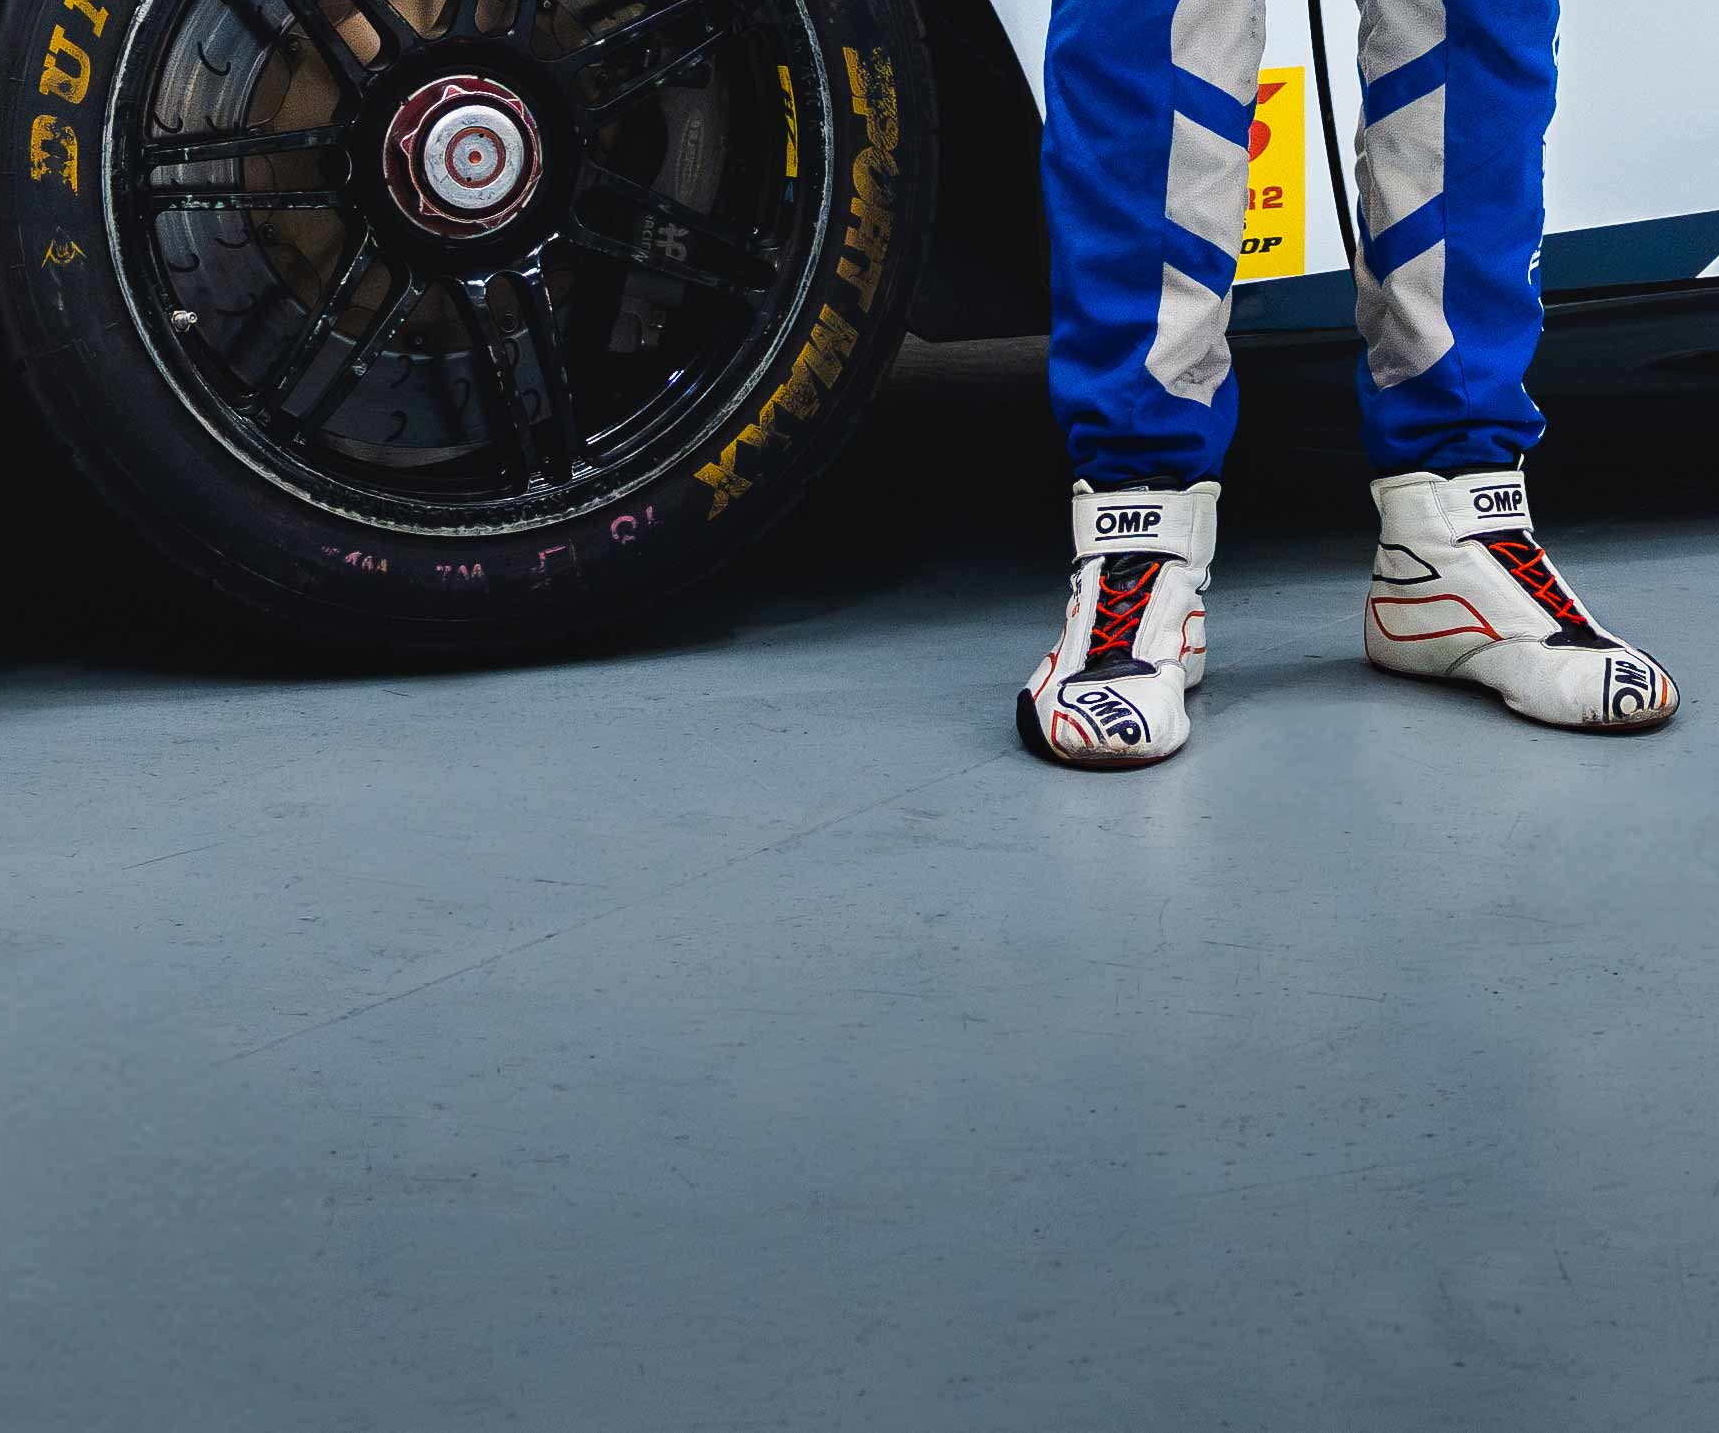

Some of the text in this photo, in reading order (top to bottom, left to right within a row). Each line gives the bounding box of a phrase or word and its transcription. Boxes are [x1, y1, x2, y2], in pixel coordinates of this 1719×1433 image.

[1473, 489, 1523, 513] OMP
[1095, 511, 1162, 534] OMP
[1611, 658, 1650, 718] OMP
[1075, 689, 1143, 746] OMP
